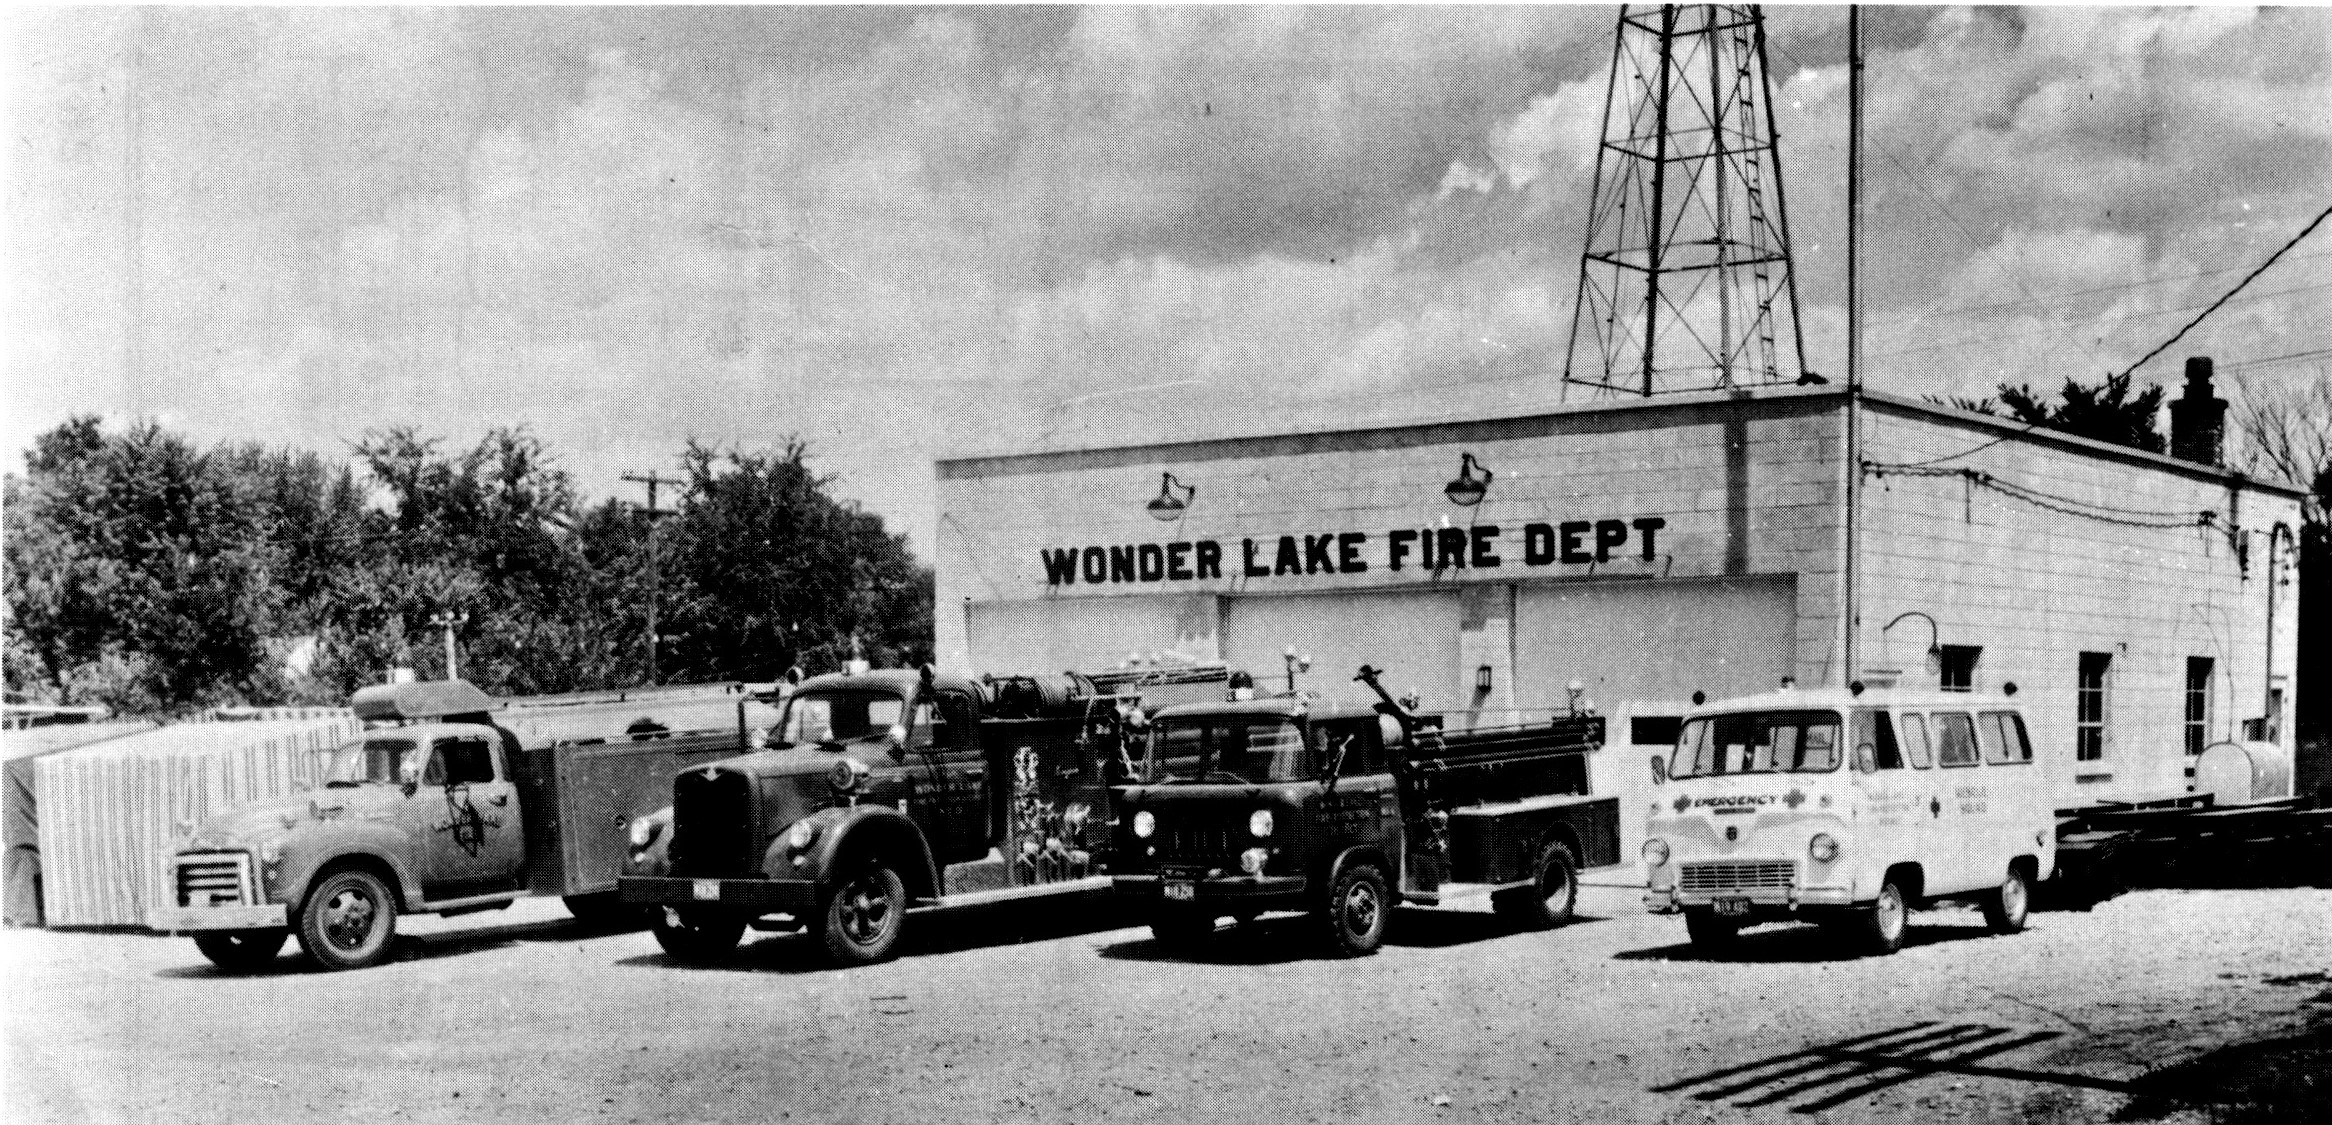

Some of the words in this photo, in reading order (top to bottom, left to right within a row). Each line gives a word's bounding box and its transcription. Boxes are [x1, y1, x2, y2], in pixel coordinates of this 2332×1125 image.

[1041, 540, 1222, 587] WONDER
[1243, 534, 1368, 577] LAKE
[1389, 527, 1501, 572] FIRE
[1524, 517, 1666, 567] DEPT
[1693, 794, 1777, 808] EMERGENCY
